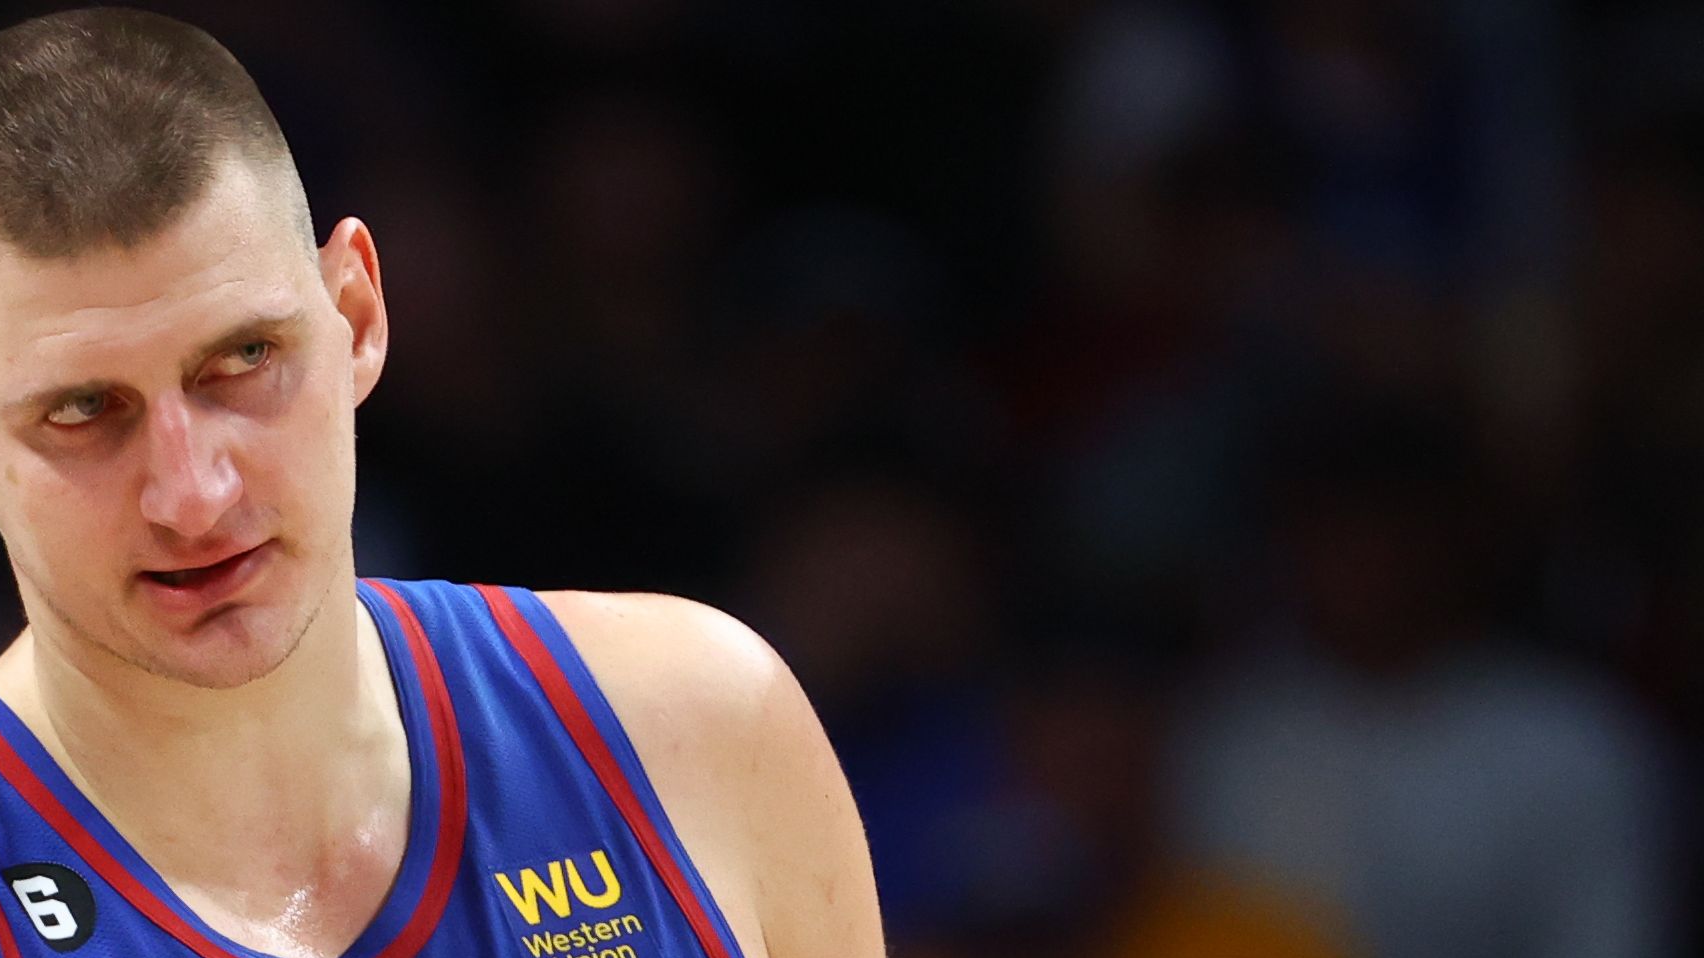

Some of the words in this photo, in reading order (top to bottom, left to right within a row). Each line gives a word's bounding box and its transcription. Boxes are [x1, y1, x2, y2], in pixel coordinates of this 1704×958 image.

[12, 875, 78, 940] 6
[495, 849, 622, 925] WU
[522, 914, 643, 958] Western
